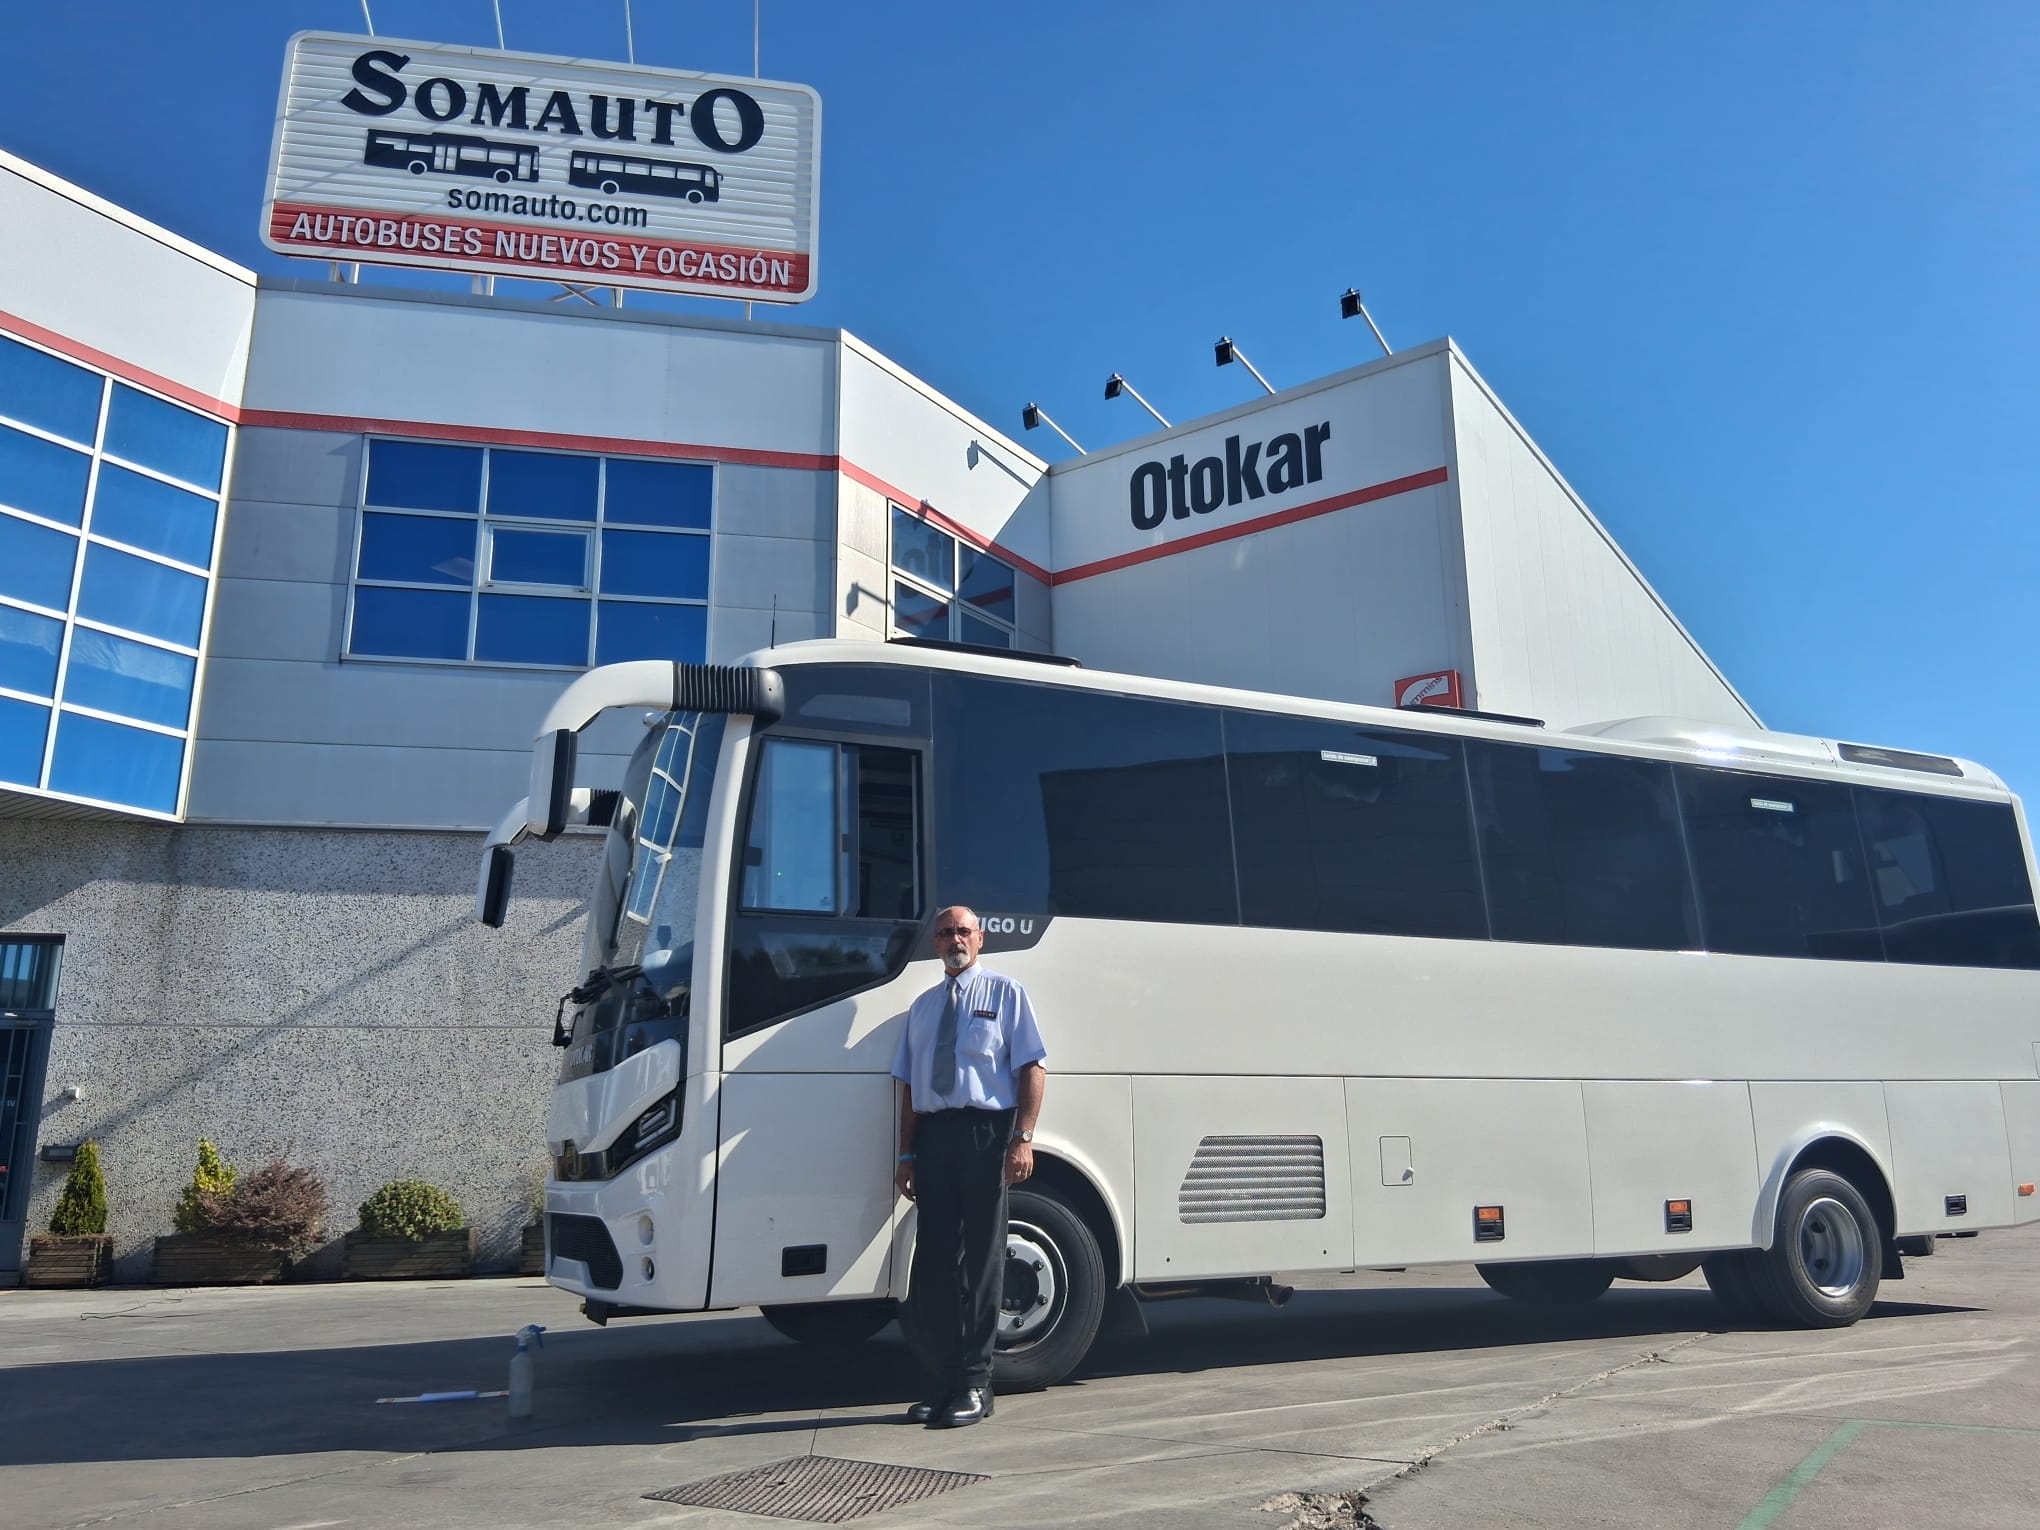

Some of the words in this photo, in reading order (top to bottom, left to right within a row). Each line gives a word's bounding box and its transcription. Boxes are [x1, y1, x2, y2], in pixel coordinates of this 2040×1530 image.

[340, 50, 765, 154] SOMAUTO
[448, 188, 648, 228] somauto.com
[290, 212, 483, 256] AUTOBUSES
[495, 230, 620, 269] NUEVOS
[630, 244, 649, 272] Y
[656, 247, 790, 287] OCASIÓN
[1129, 420, 1331, 531] Otokar
[1020, 919, 1034, 935] U
